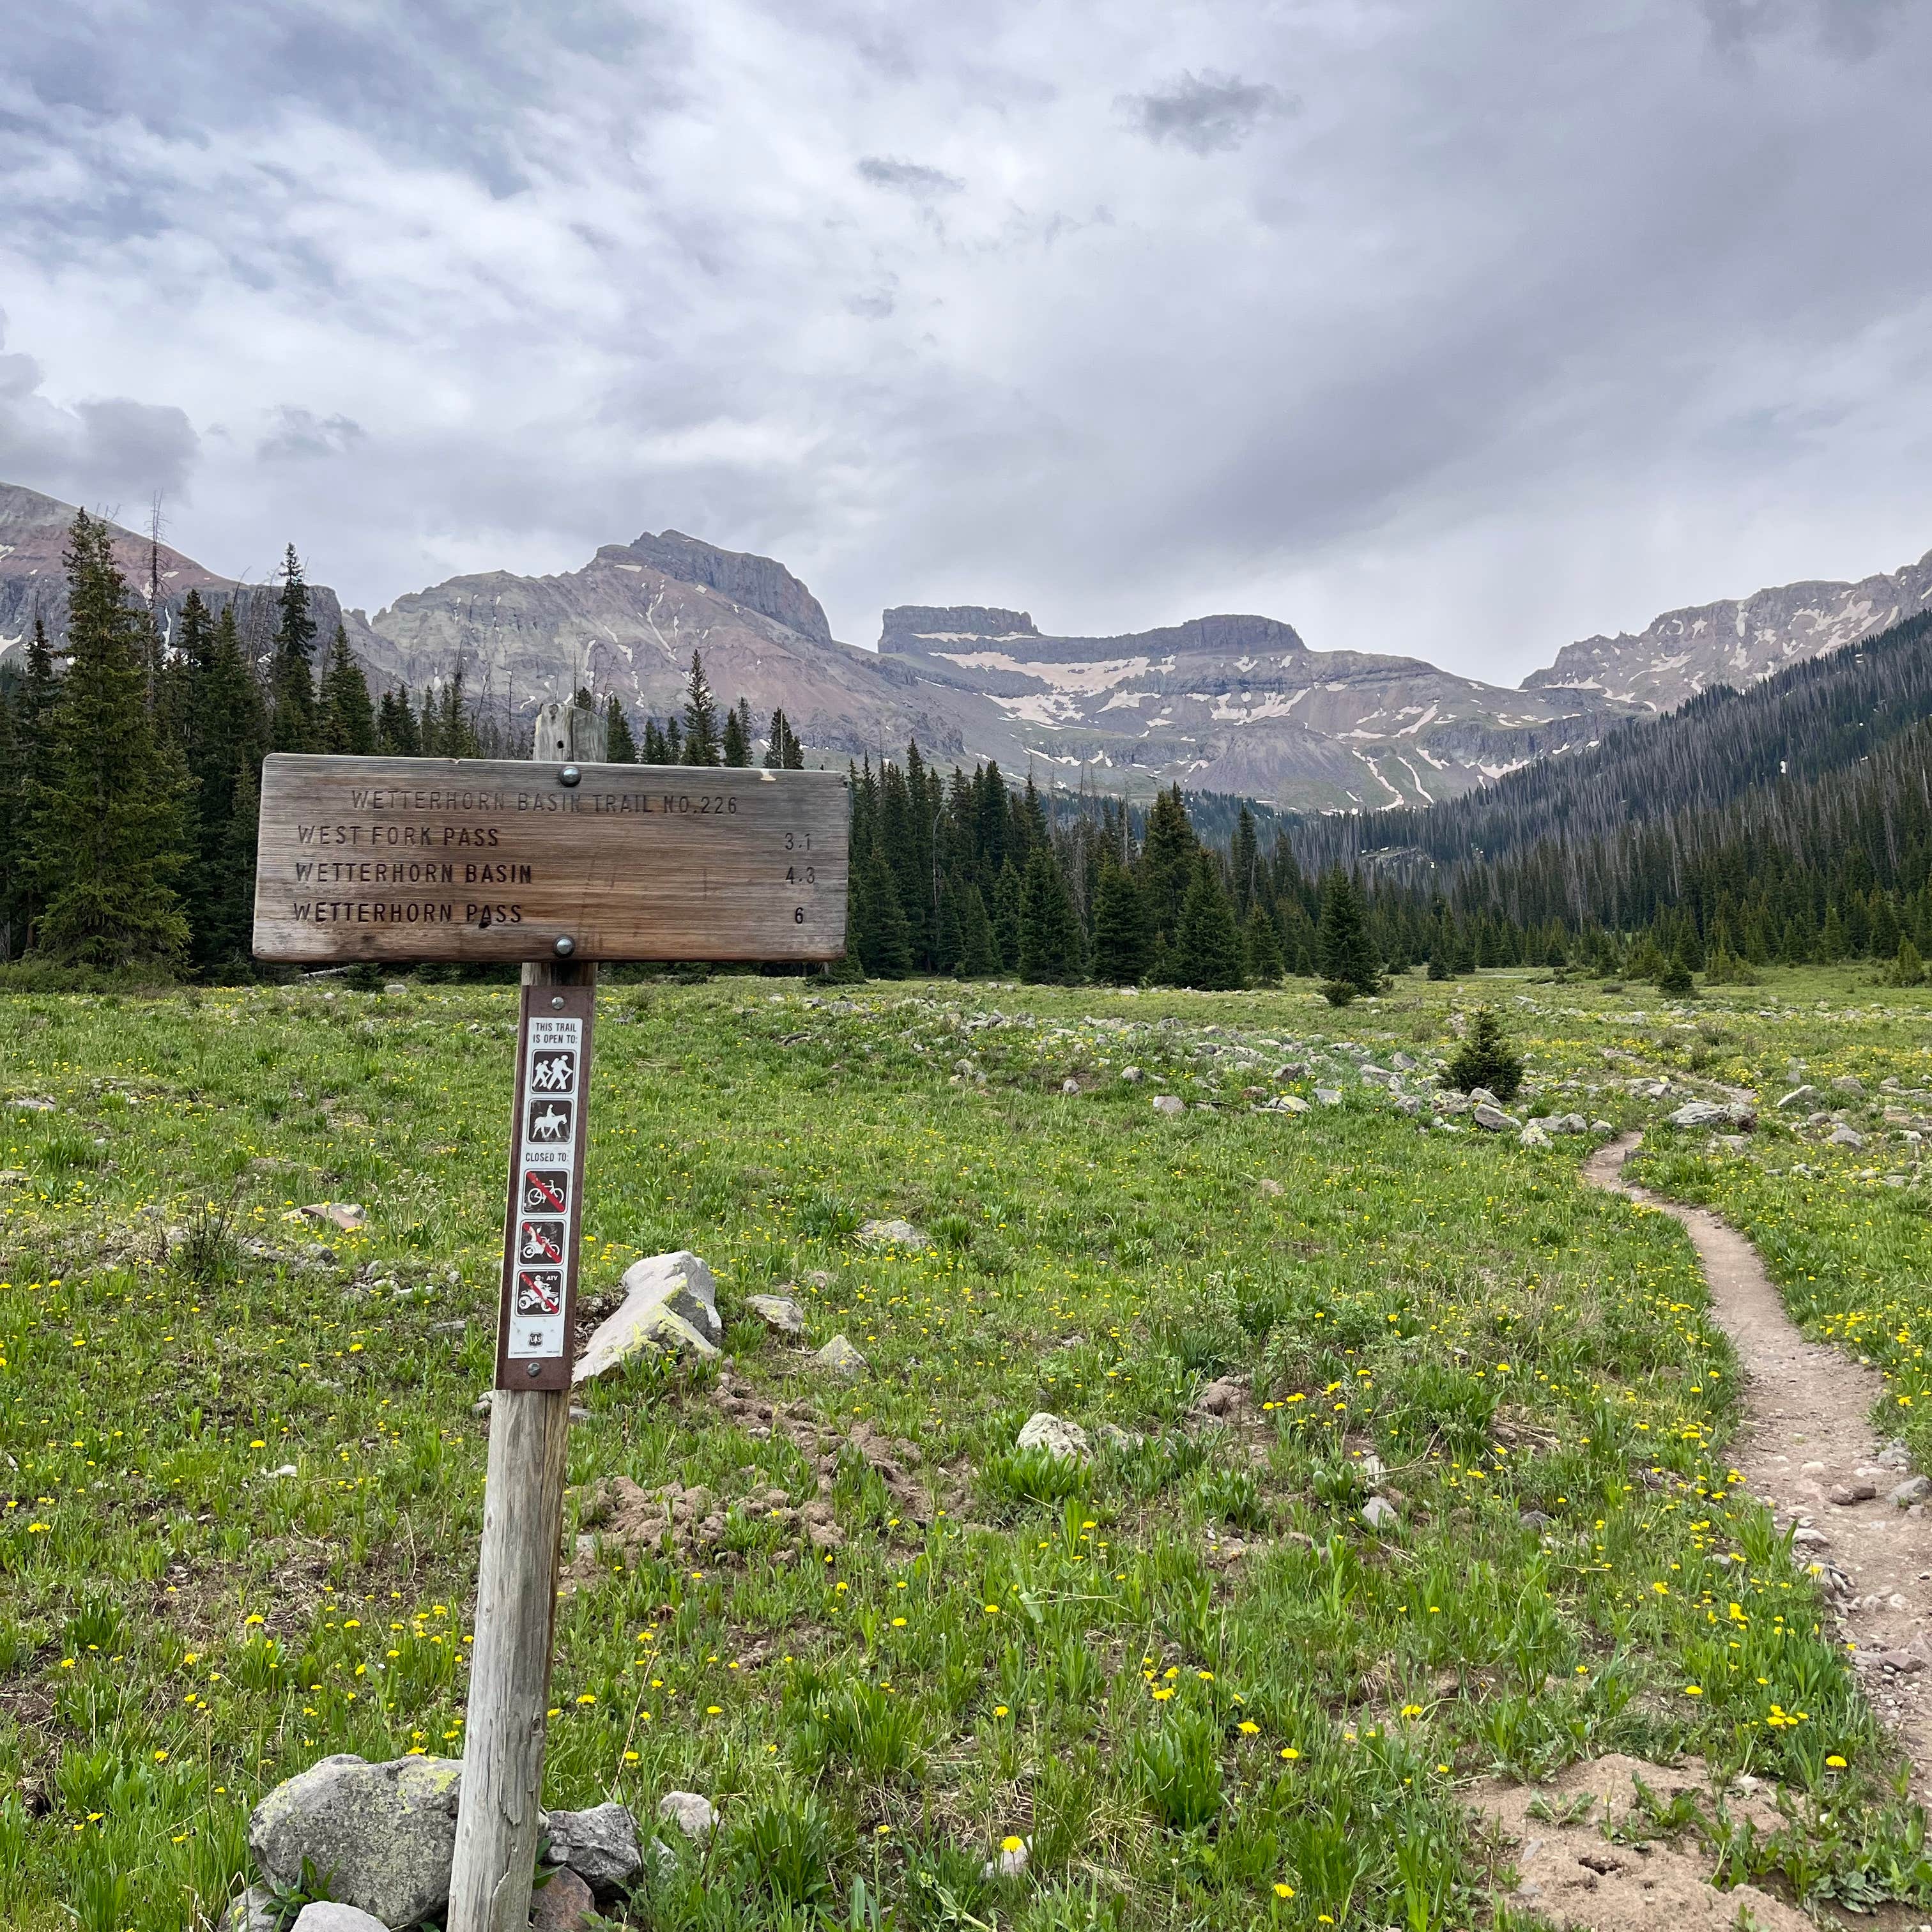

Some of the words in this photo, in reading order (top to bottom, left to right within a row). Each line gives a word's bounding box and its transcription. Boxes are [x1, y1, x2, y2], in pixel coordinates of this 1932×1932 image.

[351, 790, 504, 810] WETTERHORN
[518, 792, 580, 813] BASIN
[593, 794, 654, 813] TRAIL
[298, 825, 362, 845] WEST
[372, 826, 433, 846] FORK
[443, 827, 498, 847] PASS
[785, 832, 811, 850] 3.1
[296, 862, 453, 884] WETTERHORN
[465, 864, 532, 884] BASIN
[785, 866, 815, 885] 4.3
[293, 901, 452, 923] WETTERHORN
[466, 903, 521, 923] PASS
[795, 907, 804, 924] 6
[536, 1022, 553, 1031] THIS
[556, 1023, 576, 1032] TRAIL
[533, 1034, 540, 1043] IS
[544, 1034, 564, 1043] OPEN
[566, 1034, 578, 1044] TO:
[525, 1153, 555, 1162] CLOSED
